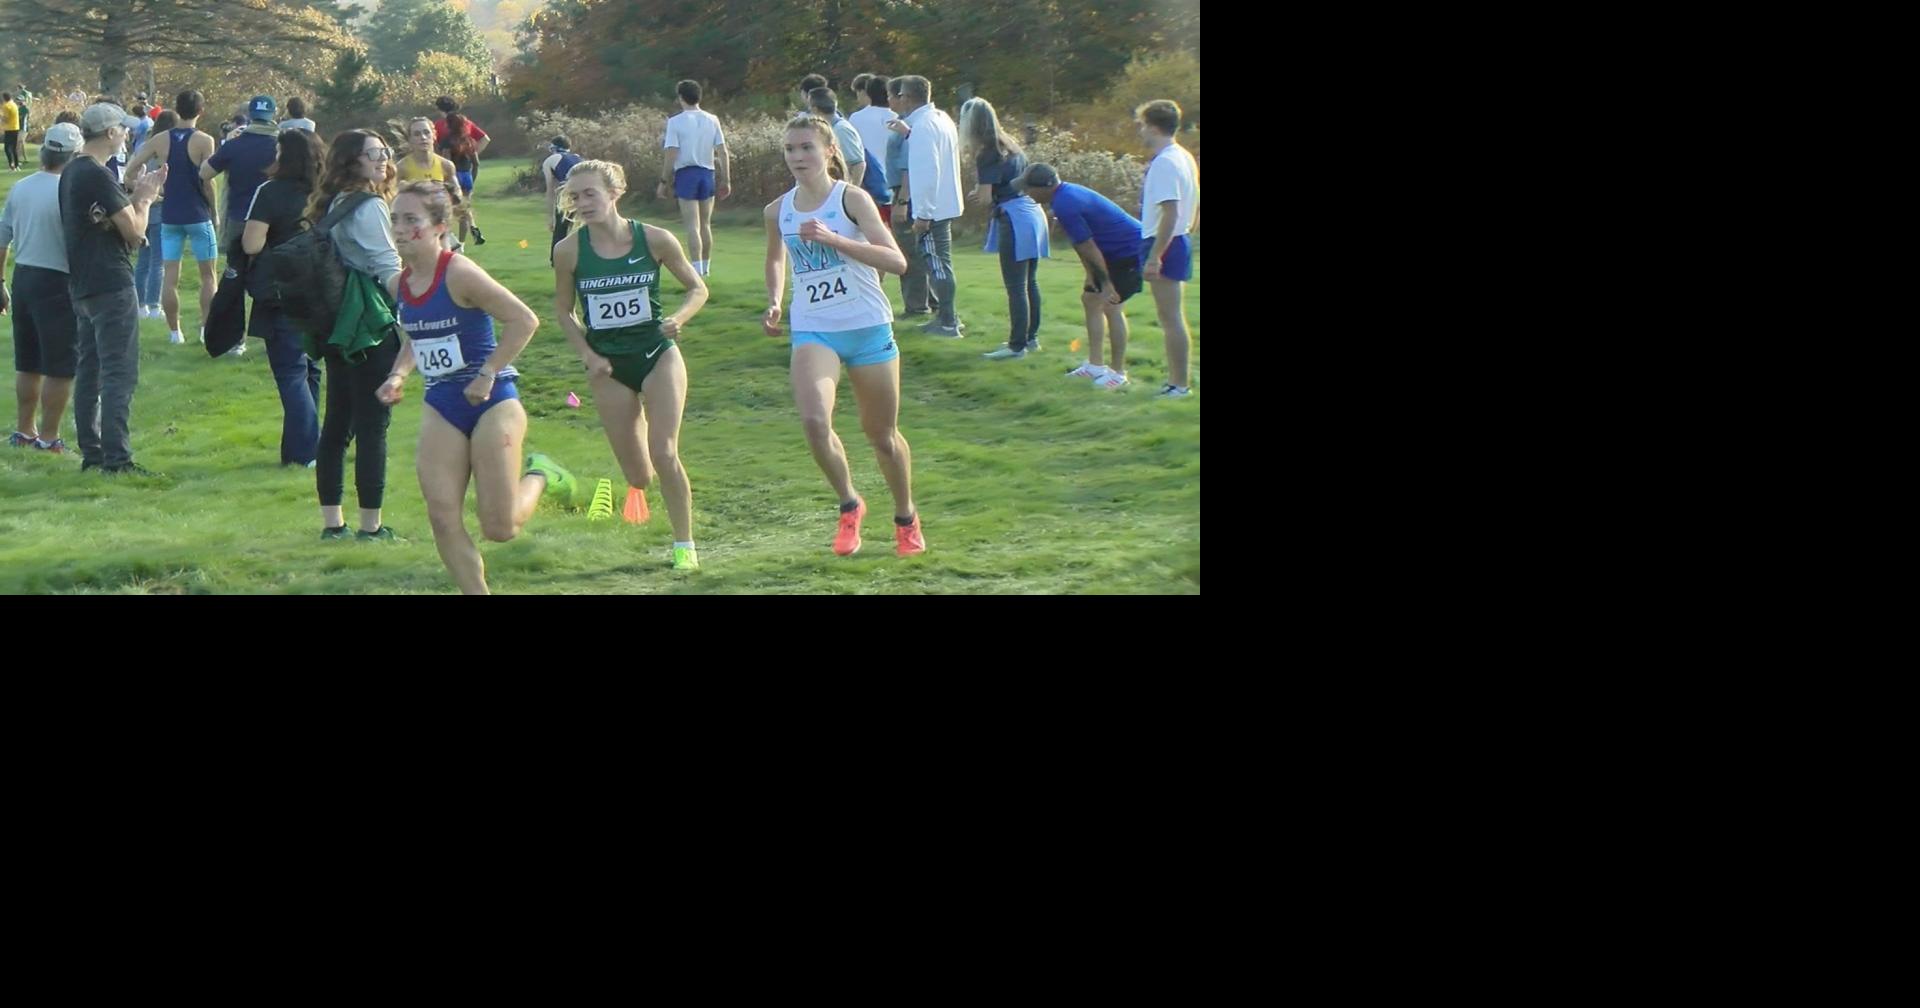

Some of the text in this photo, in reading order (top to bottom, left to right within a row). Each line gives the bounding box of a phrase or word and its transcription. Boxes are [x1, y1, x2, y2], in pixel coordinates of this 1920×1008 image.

[784, 231, 848, 274] M
[806, 277, 848, 303] 224
[599, 298, 641, 320] 205
[420, 348, 453, 371] 248
